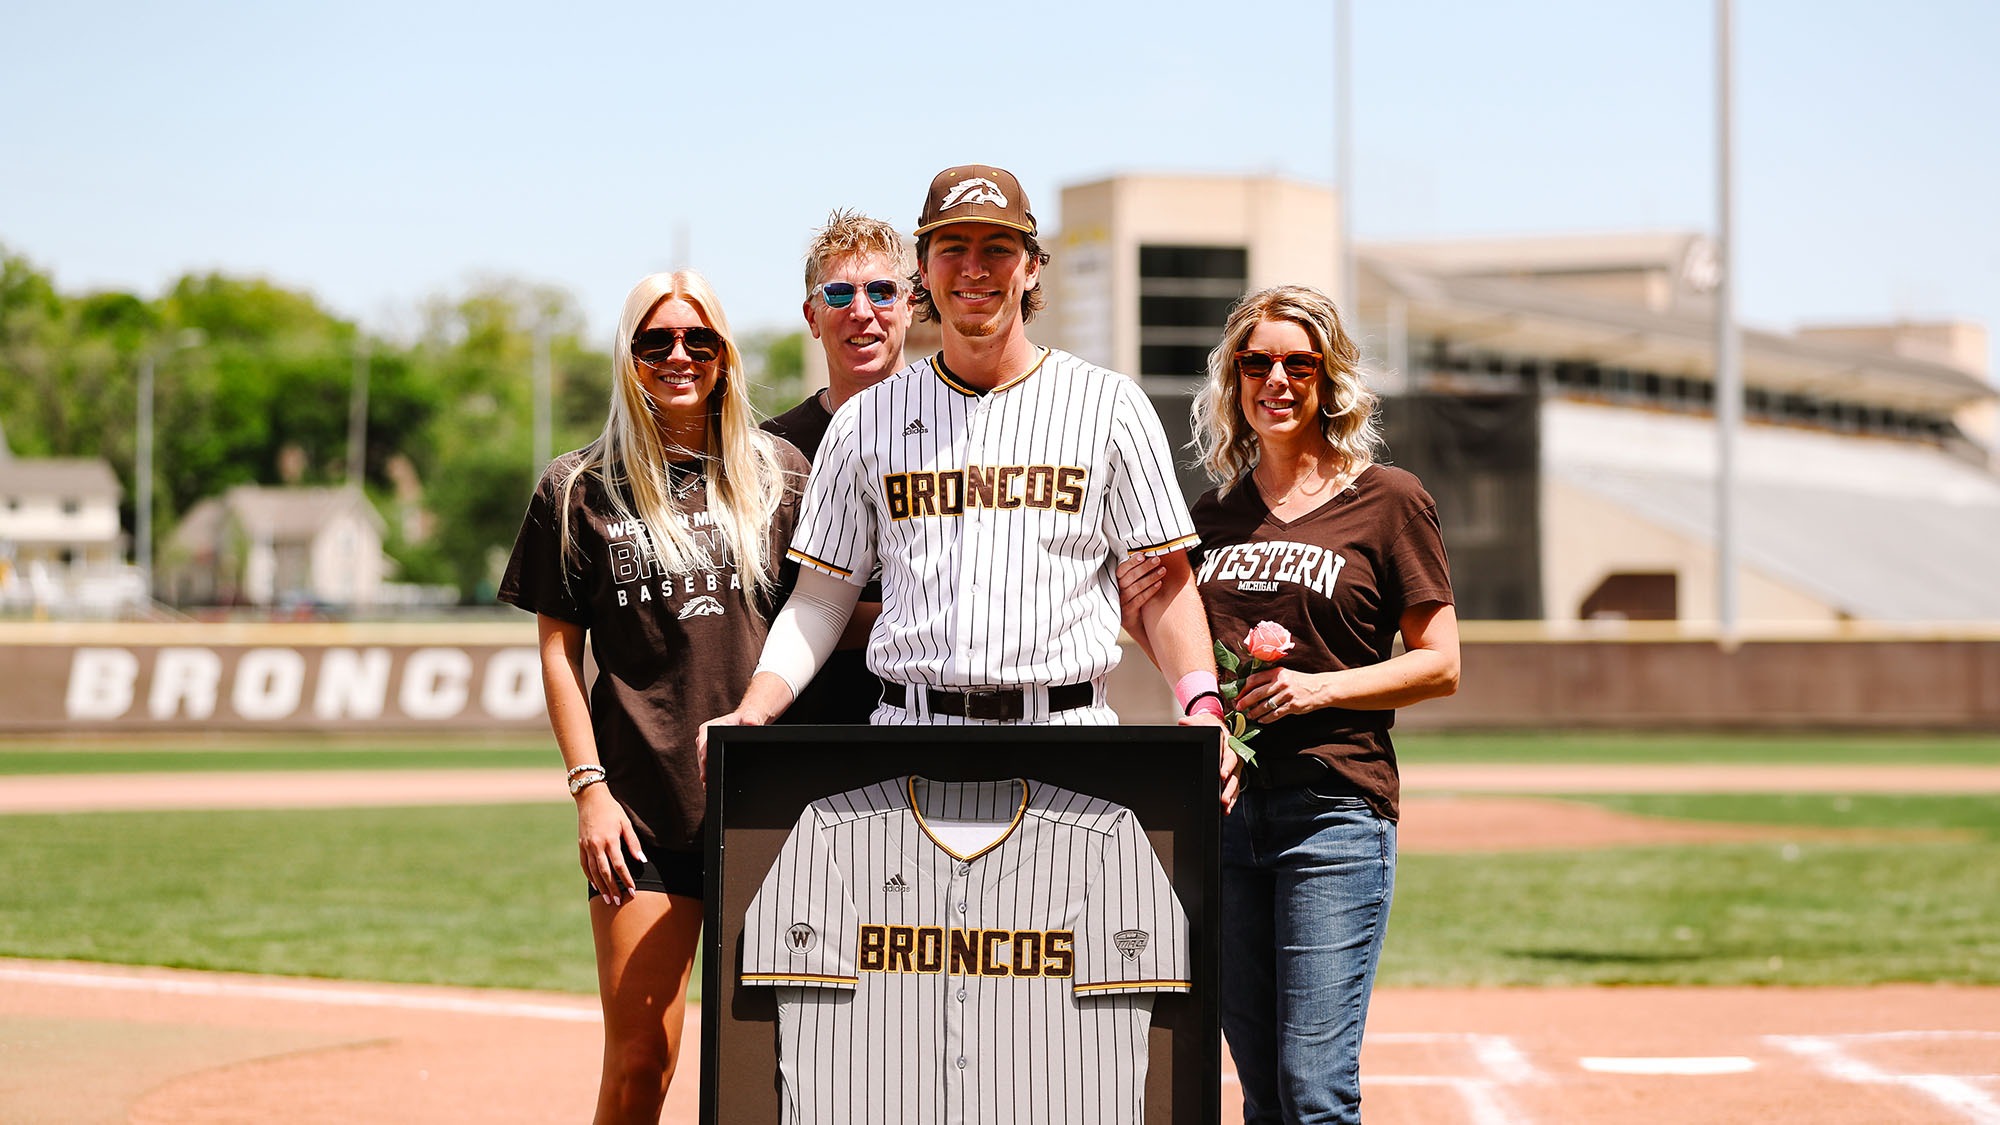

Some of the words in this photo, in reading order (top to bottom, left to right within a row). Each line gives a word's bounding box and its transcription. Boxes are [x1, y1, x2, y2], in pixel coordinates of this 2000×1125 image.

[902, 427, 928, 437] adidas
[884, 464, 1087, 522] BRONCOS
[1197, 541, 1346, 600] WESTERN
[617, 573, 742, 607] BASEBA
[1237, 580, 1279, 592] MICHIGAN
[882, 884, 910, 893] adidas
[791, 930, 811, 949] W
[858, 924, 1075, 979] BRONCOS
